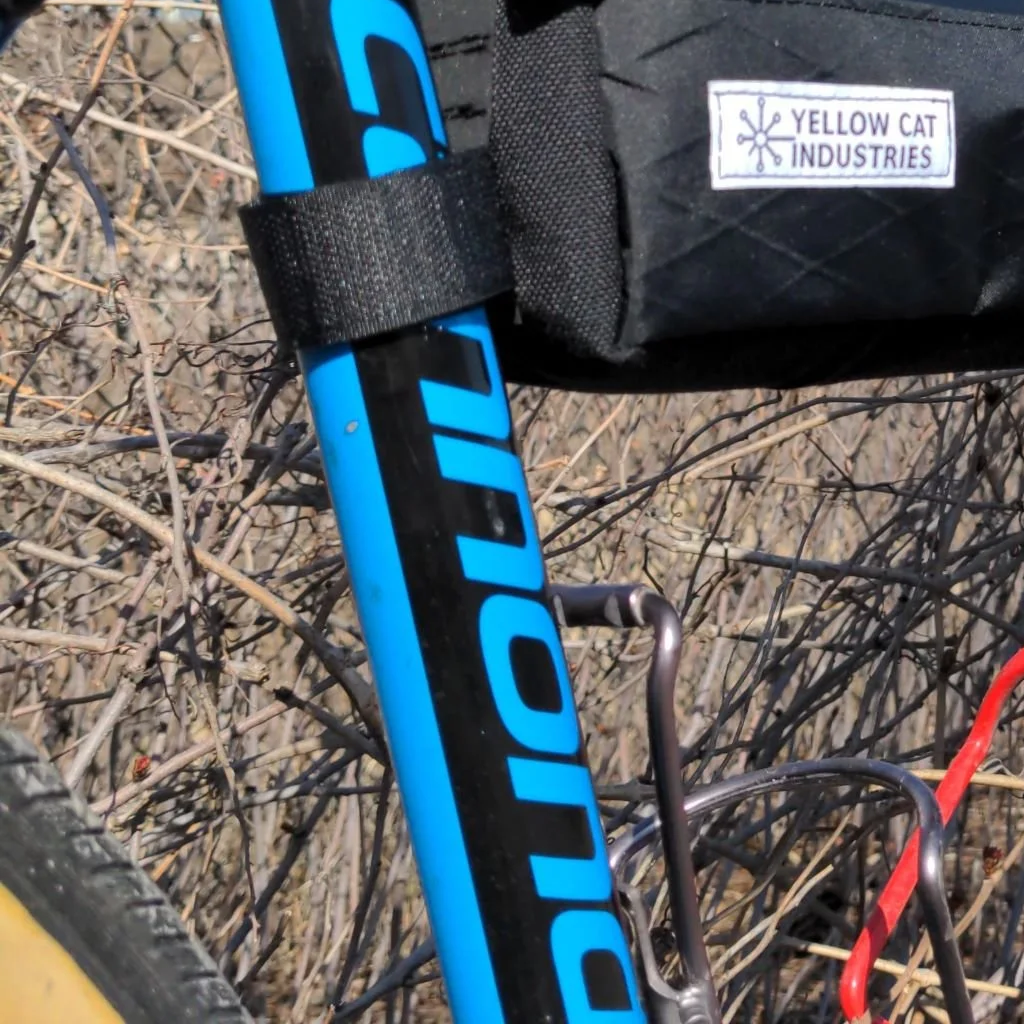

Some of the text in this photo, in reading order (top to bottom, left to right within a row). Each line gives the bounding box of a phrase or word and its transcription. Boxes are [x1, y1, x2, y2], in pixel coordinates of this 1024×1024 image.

[791, 108, 938, 138] YELLOW CAT
[790, 143, 933, 169] INDUSTRIES
